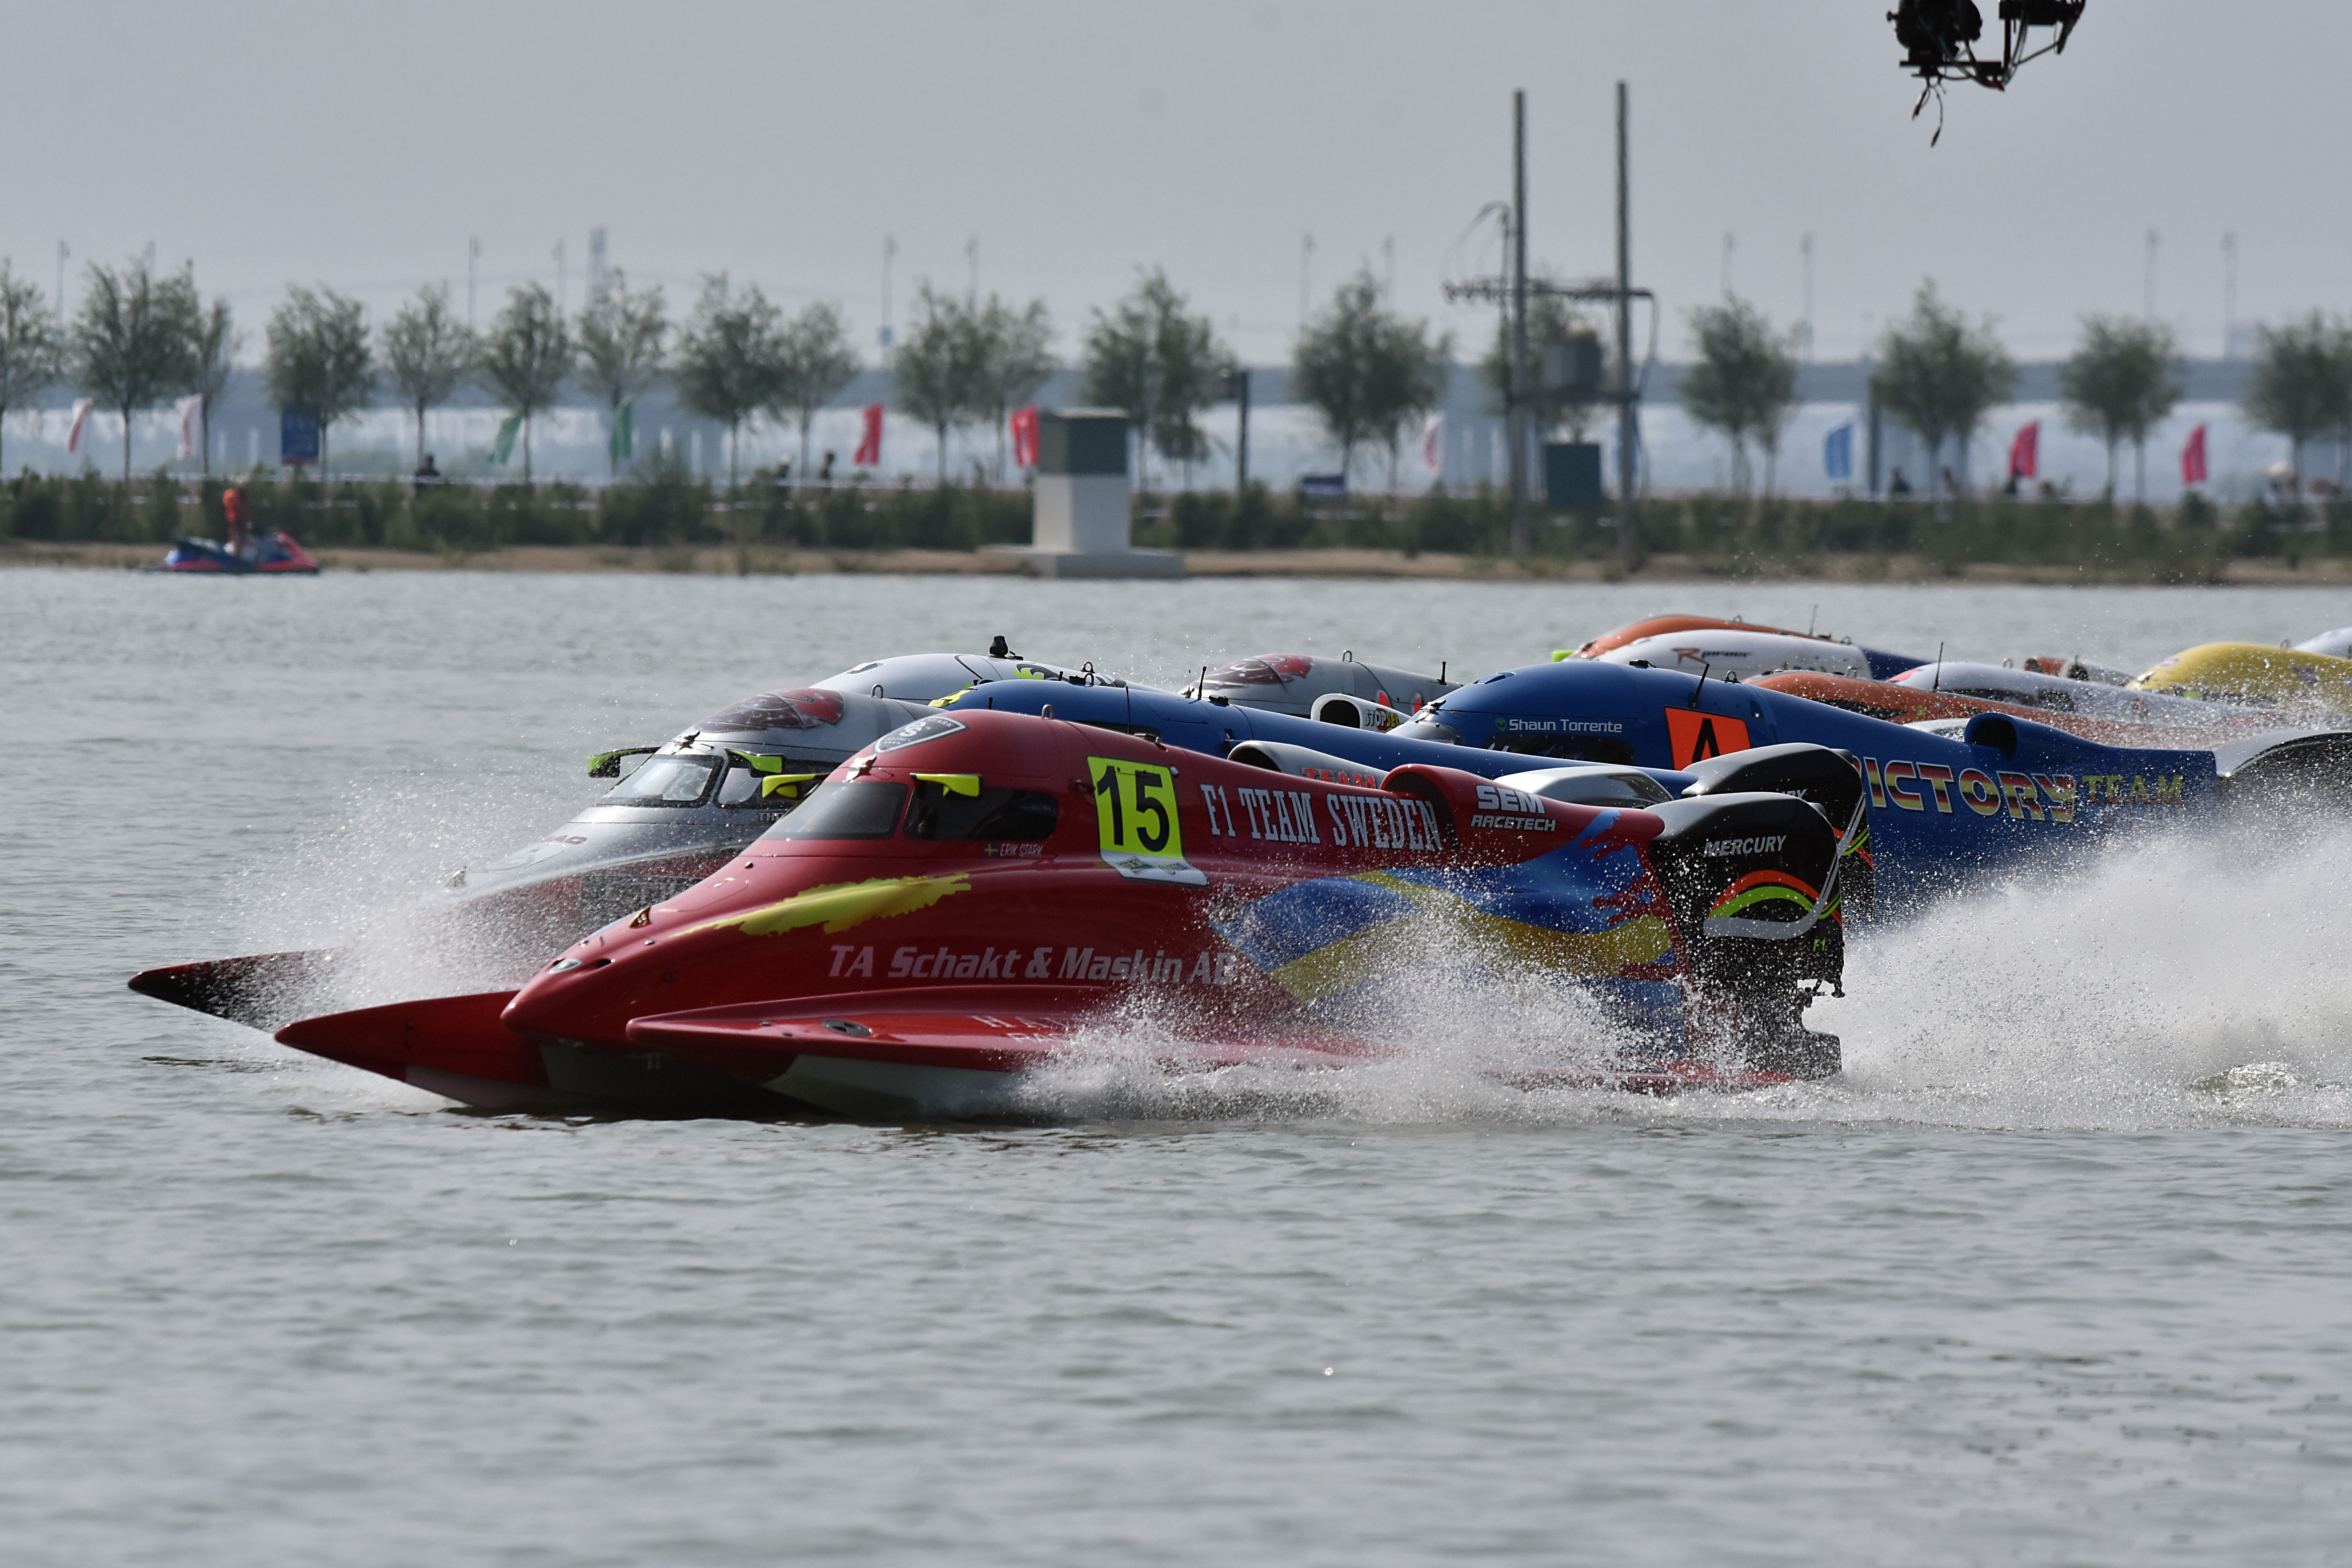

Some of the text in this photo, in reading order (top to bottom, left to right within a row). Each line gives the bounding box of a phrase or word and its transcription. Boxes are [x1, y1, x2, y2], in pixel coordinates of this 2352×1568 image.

[1509, 719, 1622, 733] Shaun Torrente
[1303, 768, 1377, 789] TEAM
[1852, 755, 2184, 823] ICTORY TEAM
[1097, 766, 1170, 852] 15
[1476, 785, 1545, 814] SEM
[1200, 784, 1443, 851] F1 TEAM SWEDEN
[1470, 814, 1556, 832] RACETECH
[1000, 844, 1043, 857] ERIK STARK
[1702, 835, 1787, 858] MERCURY
[1813, 937, 1826, 952] F1
[828, 945, 874, 977] TA
[887, 947, 1022, 978] Schakt
[1024, 947, 1053, 978] &
[1058, 947, 1183, 982] Maskin
